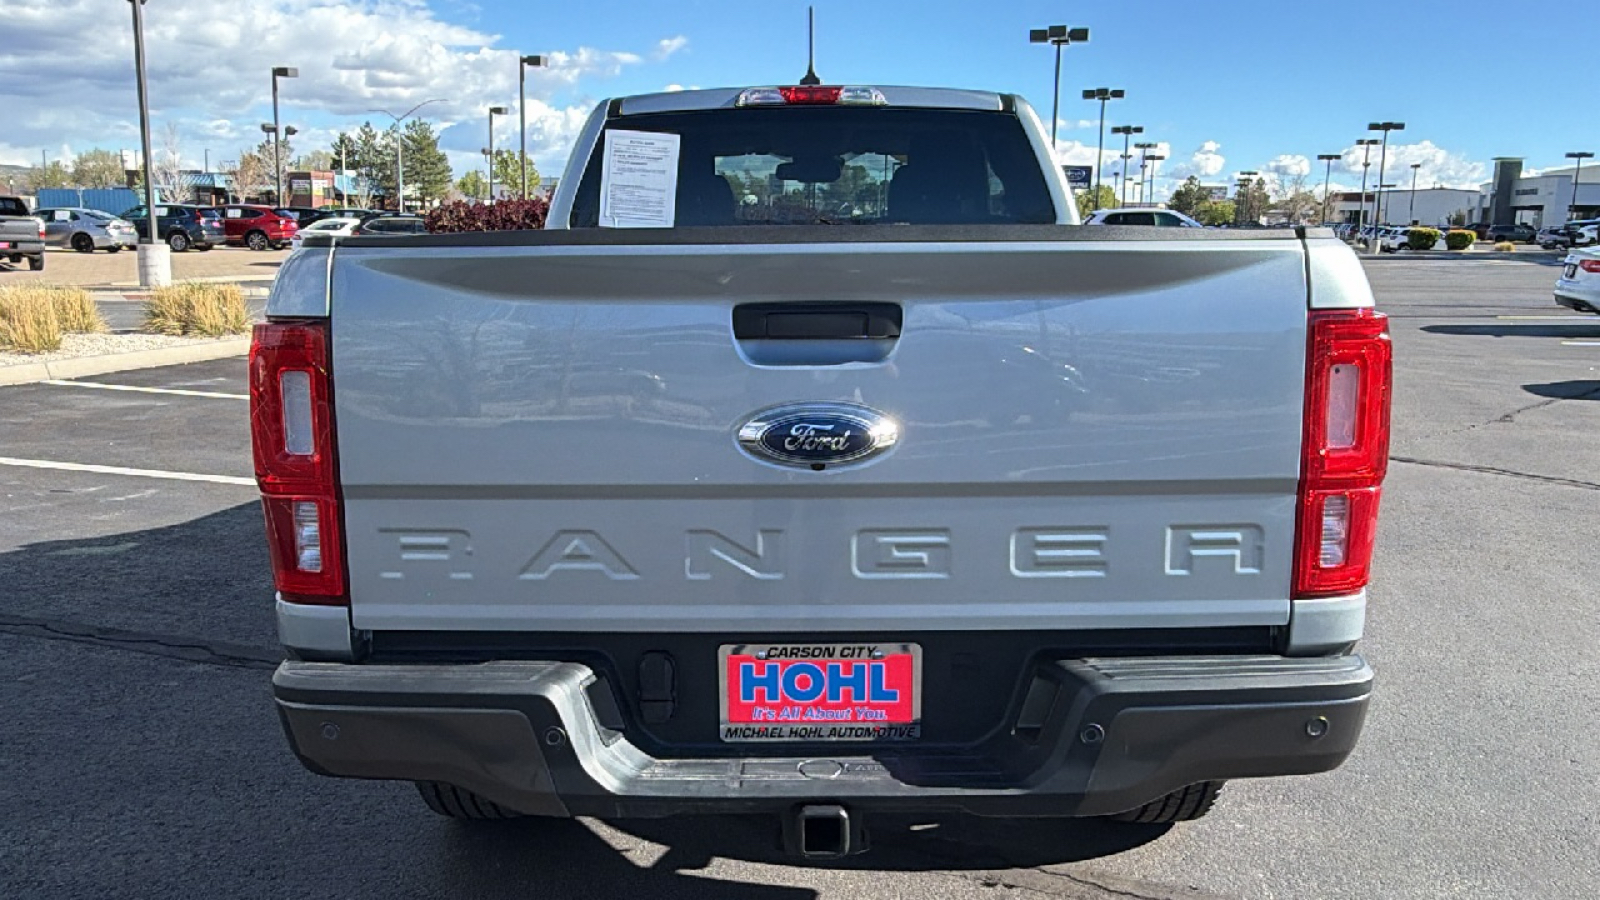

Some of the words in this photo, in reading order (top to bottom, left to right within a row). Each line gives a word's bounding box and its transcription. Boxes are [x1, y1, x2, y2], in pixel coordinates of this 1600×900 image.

[784, 423, 851, 451] Ford
[377, 522, 1266, 580] RANGER
[767, 646, 835, 658] CARSON
[839, 646, 877, 658] CITY
[740, 662, 899, 702] HOHL
[752, 706, 776, 720] It's
[779, 706, 800, 720] All
[804, 706, 851, 720] About
[724, 727, 784, 739] MICHAEL
[788, 727, 826, 739] HOHL
[829, 726, 915, 739] AUTOMOTIVE
